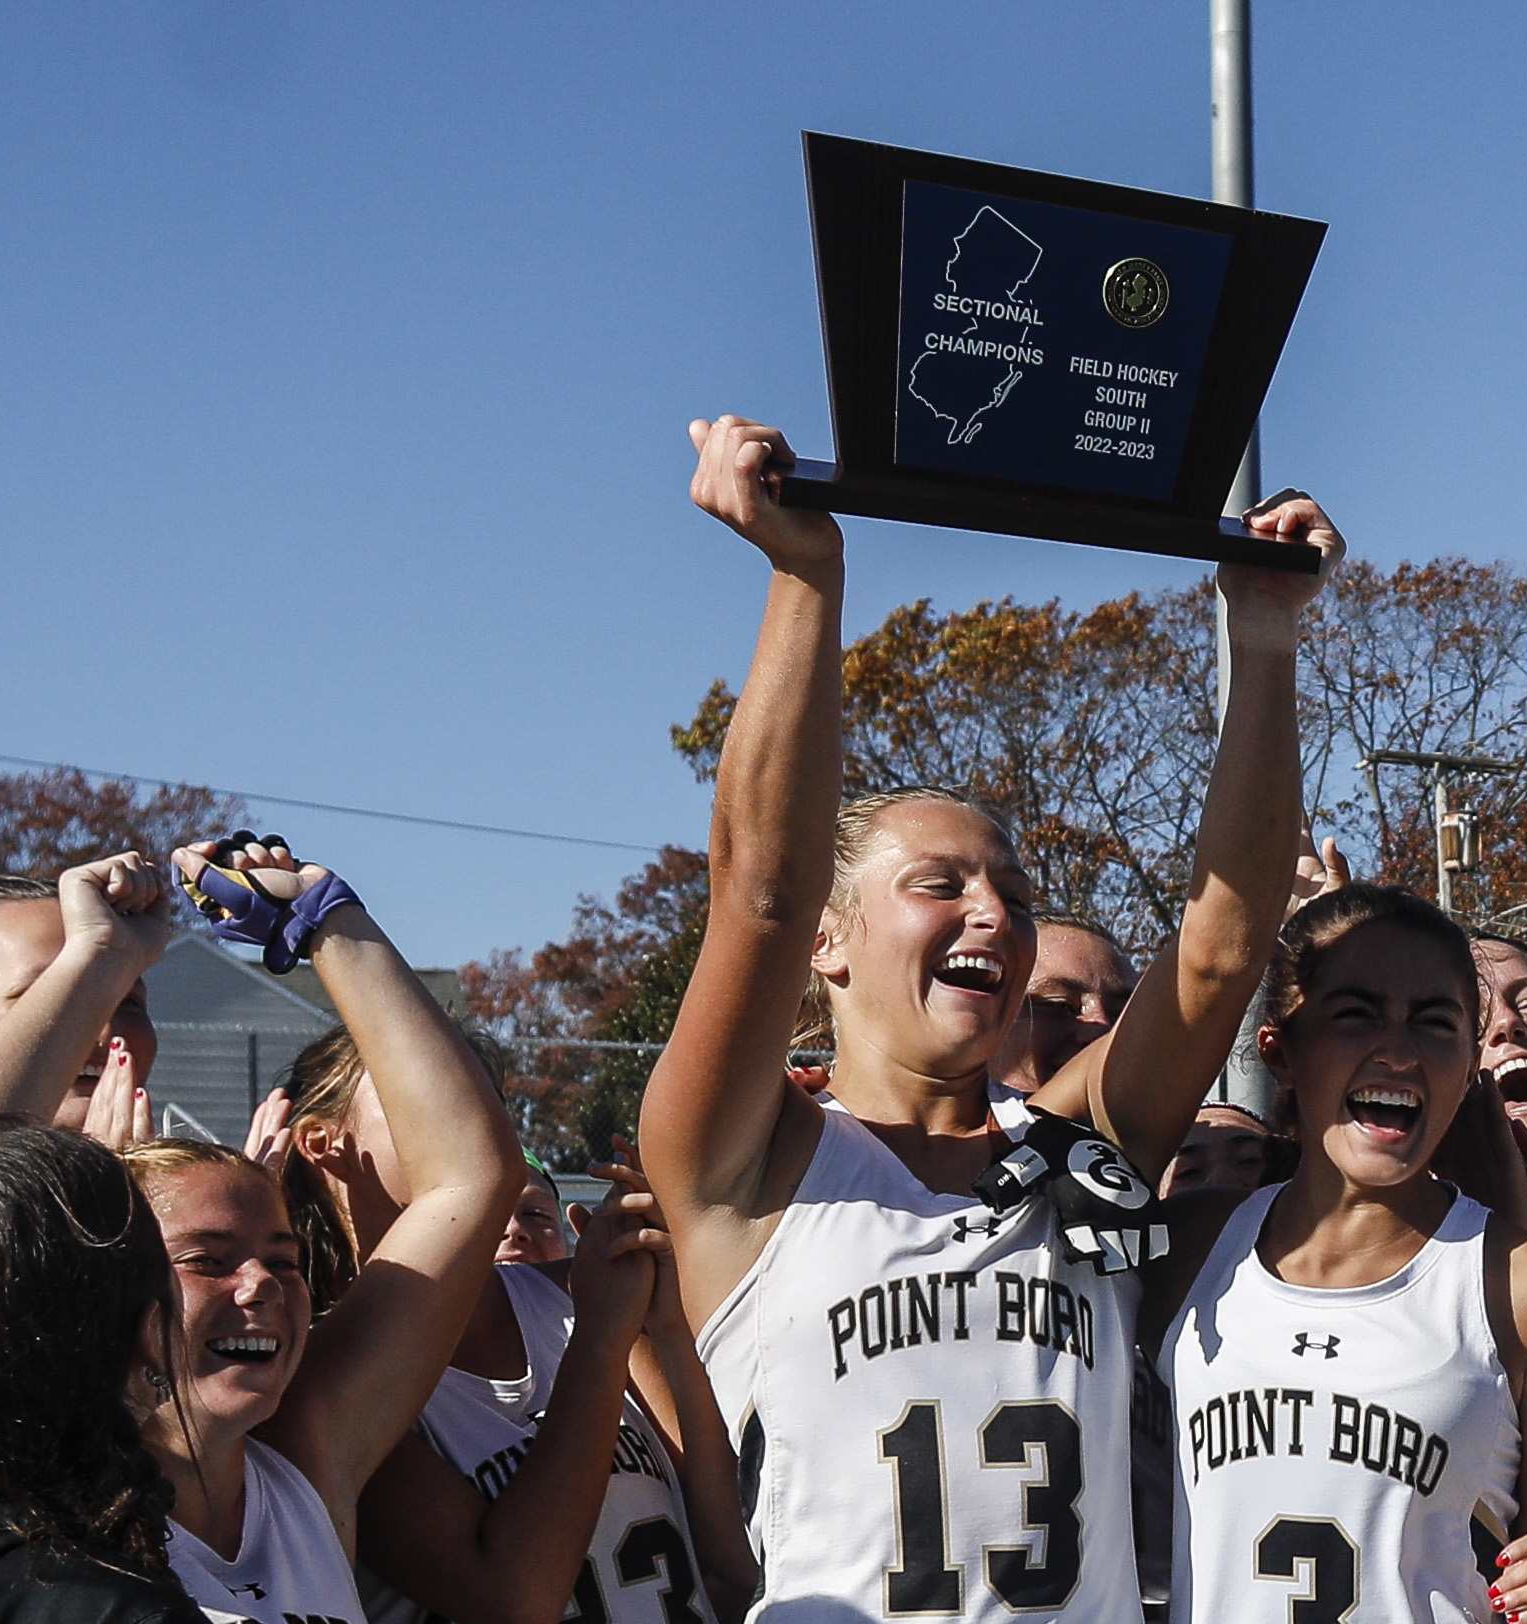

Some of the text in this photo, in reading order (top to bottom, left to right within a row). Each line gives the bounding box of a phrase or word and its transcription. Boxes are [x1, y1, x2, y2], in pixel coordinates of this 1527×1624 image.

[933, 293, 1044, 326] SECTIONAL
[924, 332, 1044, 365] CHAMPIONS
[1069, 356, 1179, 388] FIELD HOCKEY
[1095, 385, 1147, 408] SOUTH
[1084, 409, 1151, 434] GROUP II
[1074, 434, 1155, 460] 2022-2023
[825, 1270, 1096, 1383] POINT BORO
[1187, 1387, 1315, 1489] POINT
[1327, 1391, 1450, 1498] BORO
[876, 1398, 1087, 1619] 13
